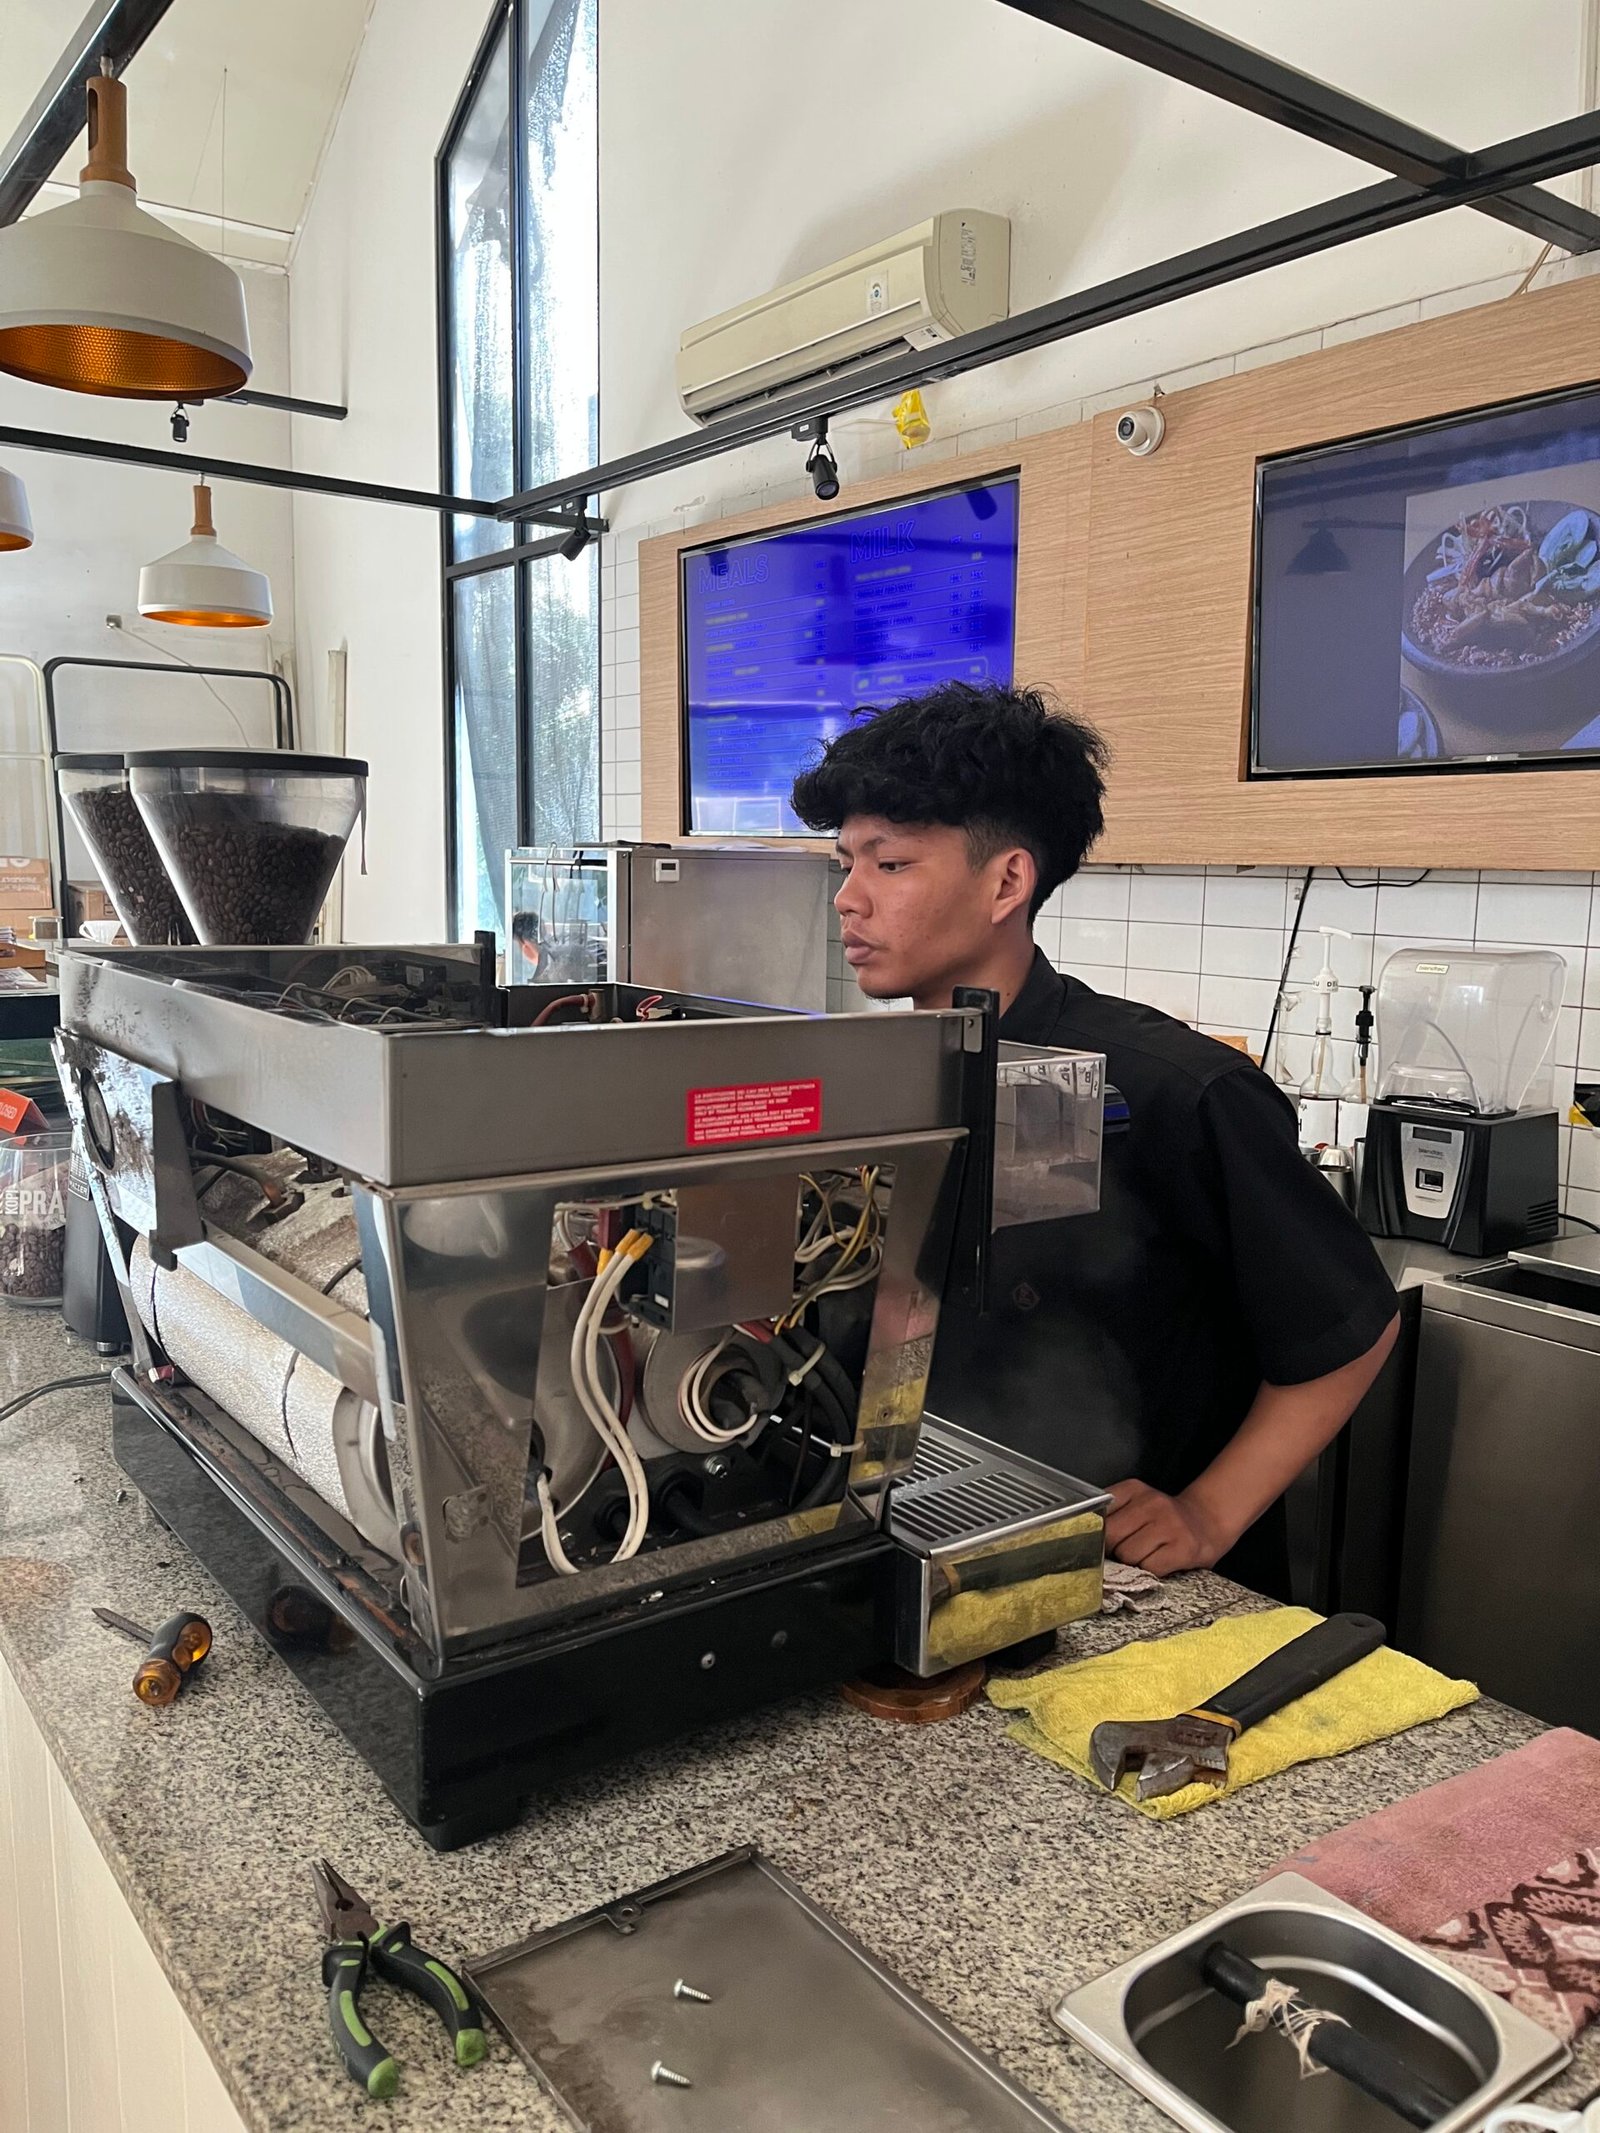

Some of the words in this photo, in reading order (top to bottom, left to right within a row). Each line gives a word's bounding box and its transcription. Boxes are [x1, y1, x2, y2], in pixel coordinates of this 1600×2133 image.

[850, 519, 916, 564] MILK
[698, 553, 769, 593] MEALS
[5, 1189, 19, 1215] KOPI
[19, 1190, 65, 1215] PRA
